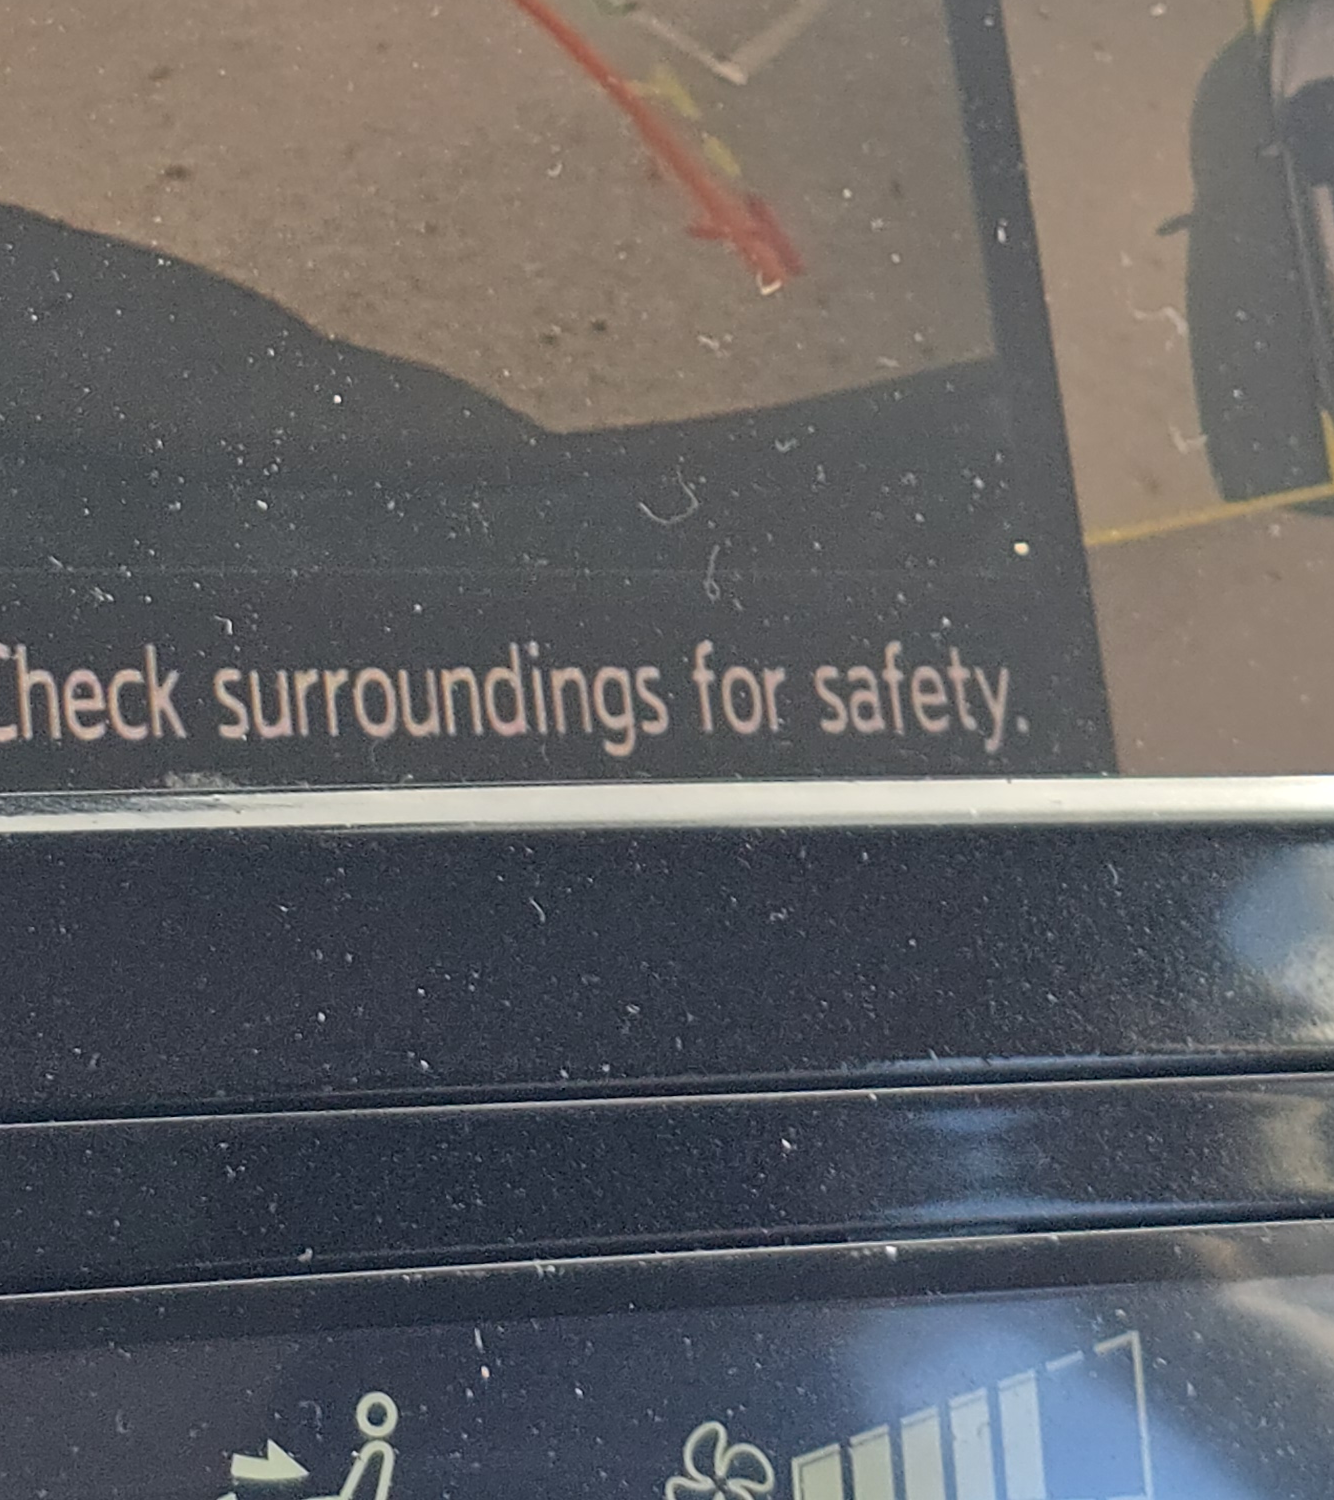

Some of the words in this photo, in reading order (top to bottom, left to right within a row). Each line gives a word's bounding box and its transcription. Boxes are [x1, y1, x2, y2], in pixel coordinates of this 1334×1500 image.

[214, 639, 668, 757] surroundings
[692, 639, 786, 734] for
[815, 640, 1029, 754] safety.
